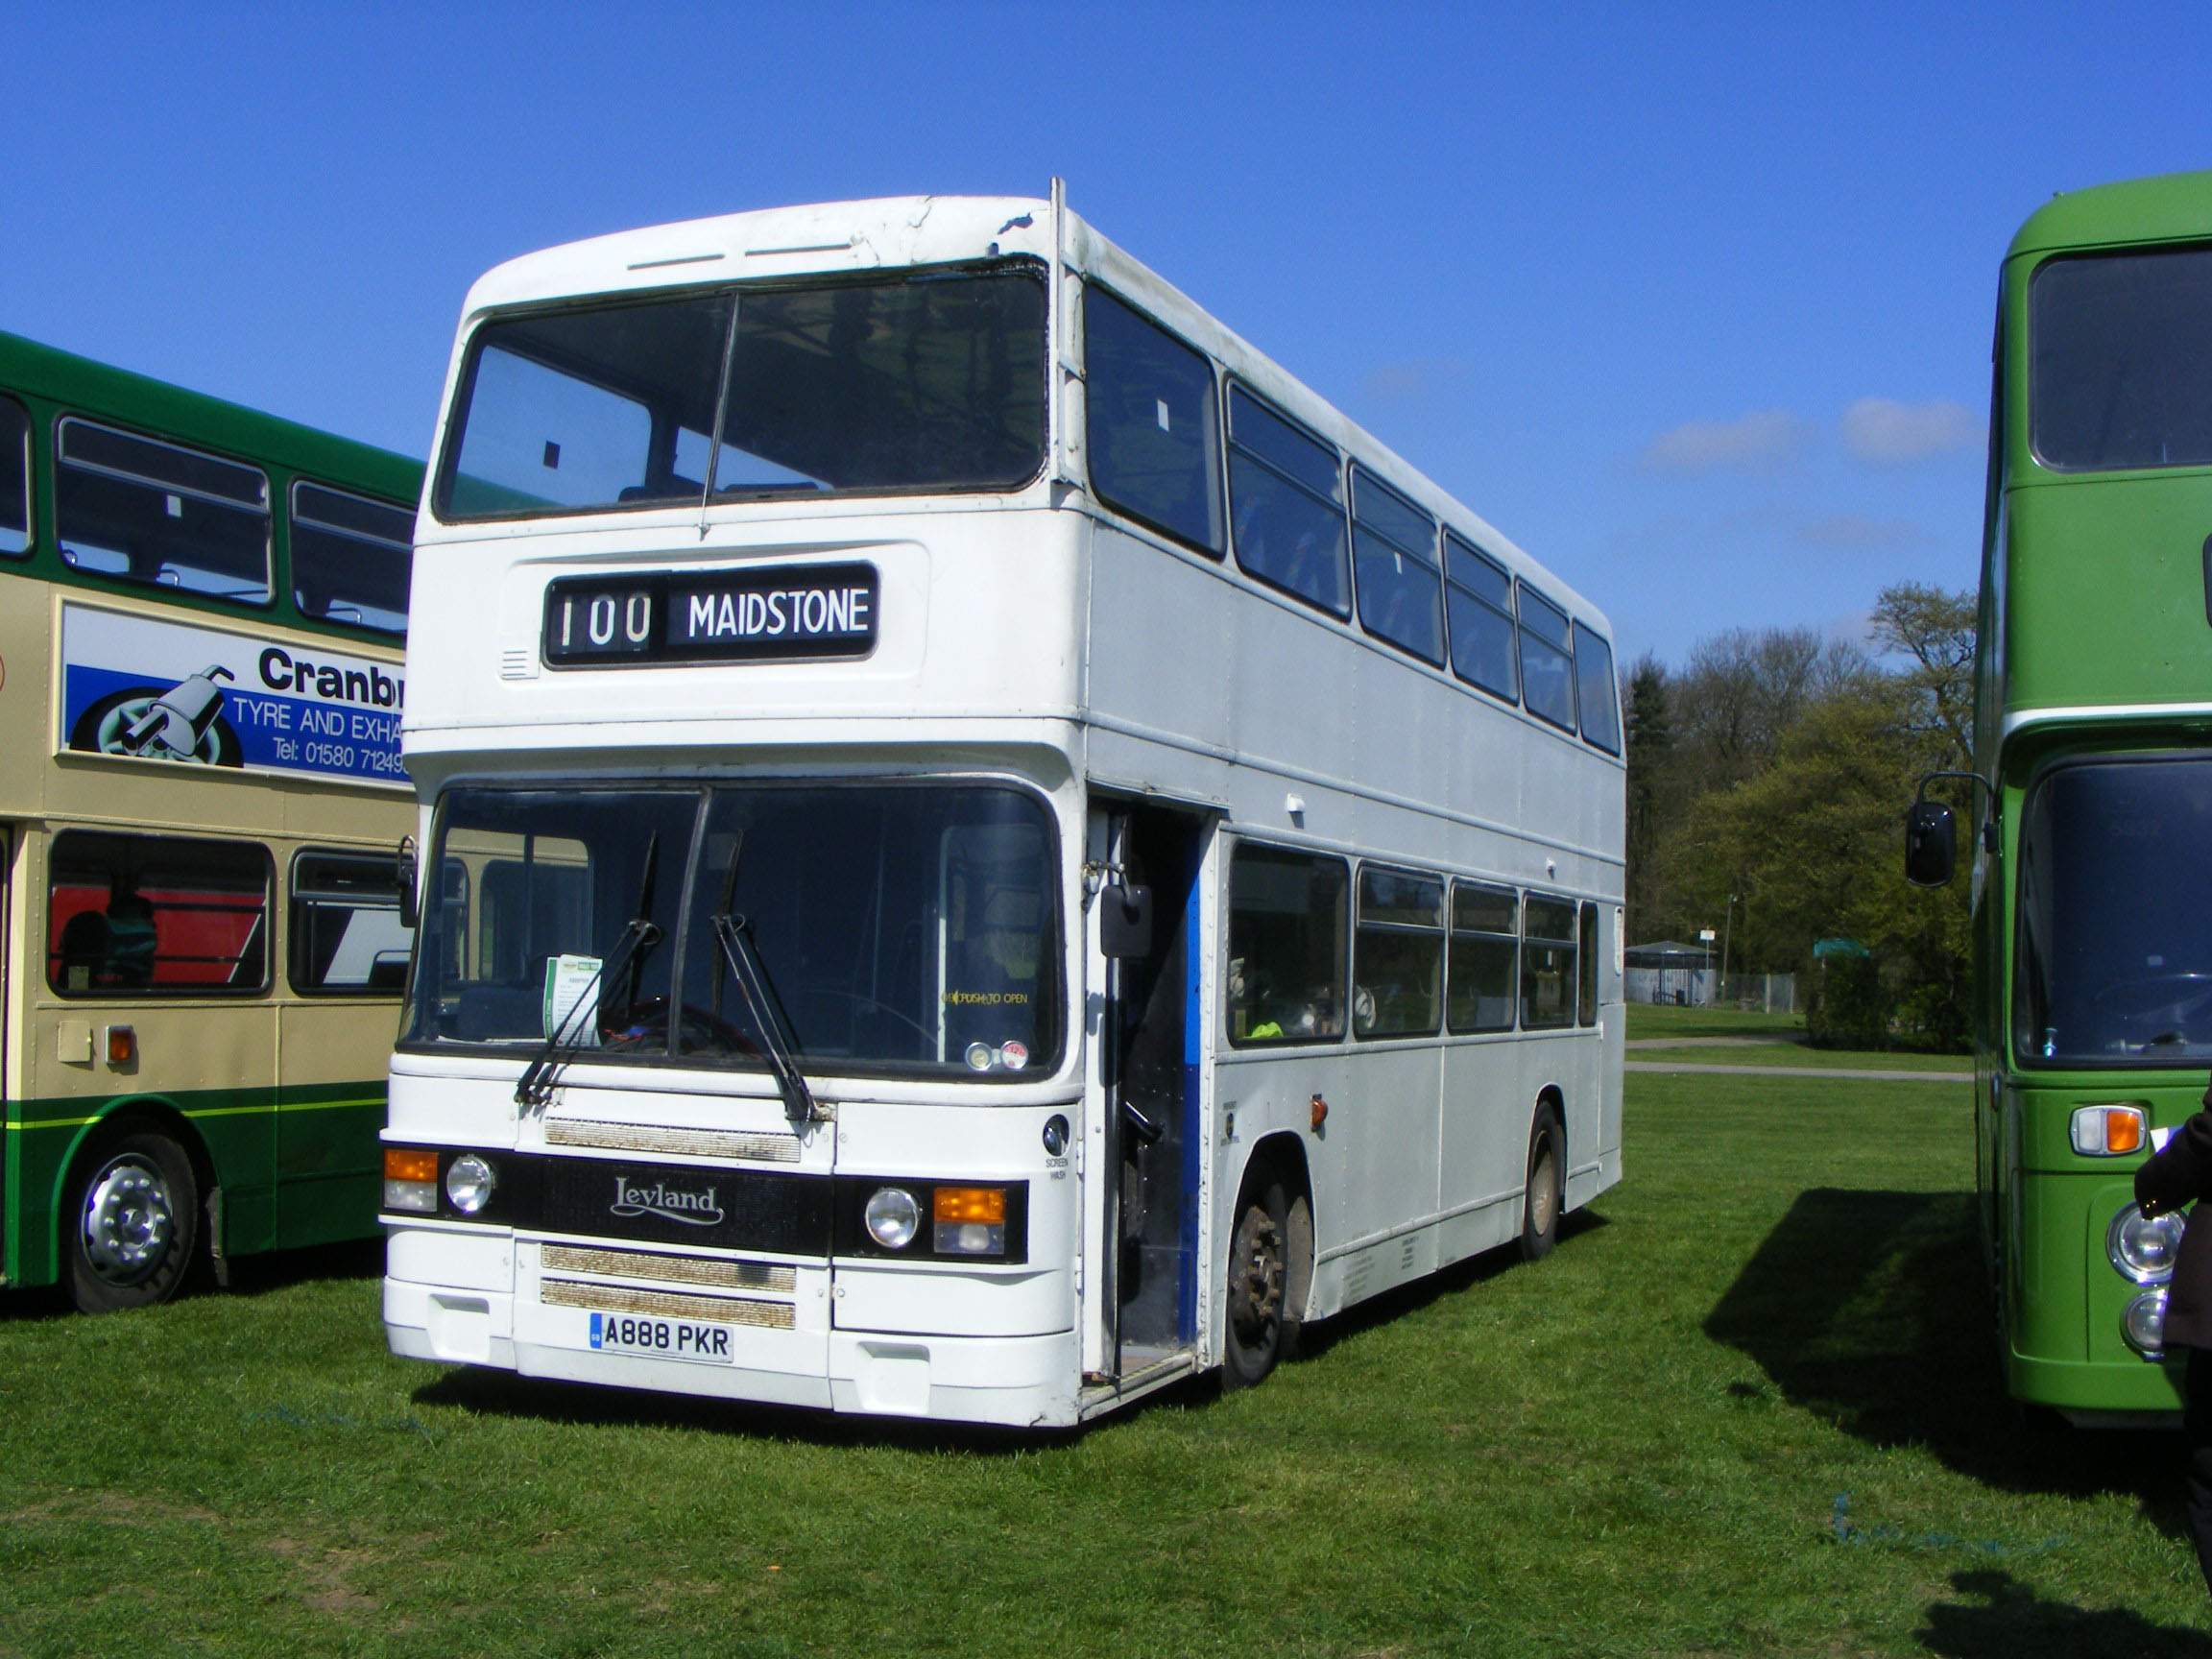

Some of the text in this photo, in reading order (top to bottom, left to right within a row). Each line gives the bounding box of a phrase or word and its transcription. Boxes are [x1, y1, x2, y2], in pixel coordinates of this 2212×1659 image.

[561, 588, 869, 647] 100 MAIDSTONE
[232, 696, 402, 744] TYRE AND EXHA
[273, 736, 300, 761] Tel:
[305, 743, 355, 769] 01580
[1003, 993, 1028, 1004] OPEN
[1046, 1158, 1069, 1168] SCREEN
[613, 1177, 722, 1219] Leyland
[605, 1317, 729, 1356] A888 PKR
